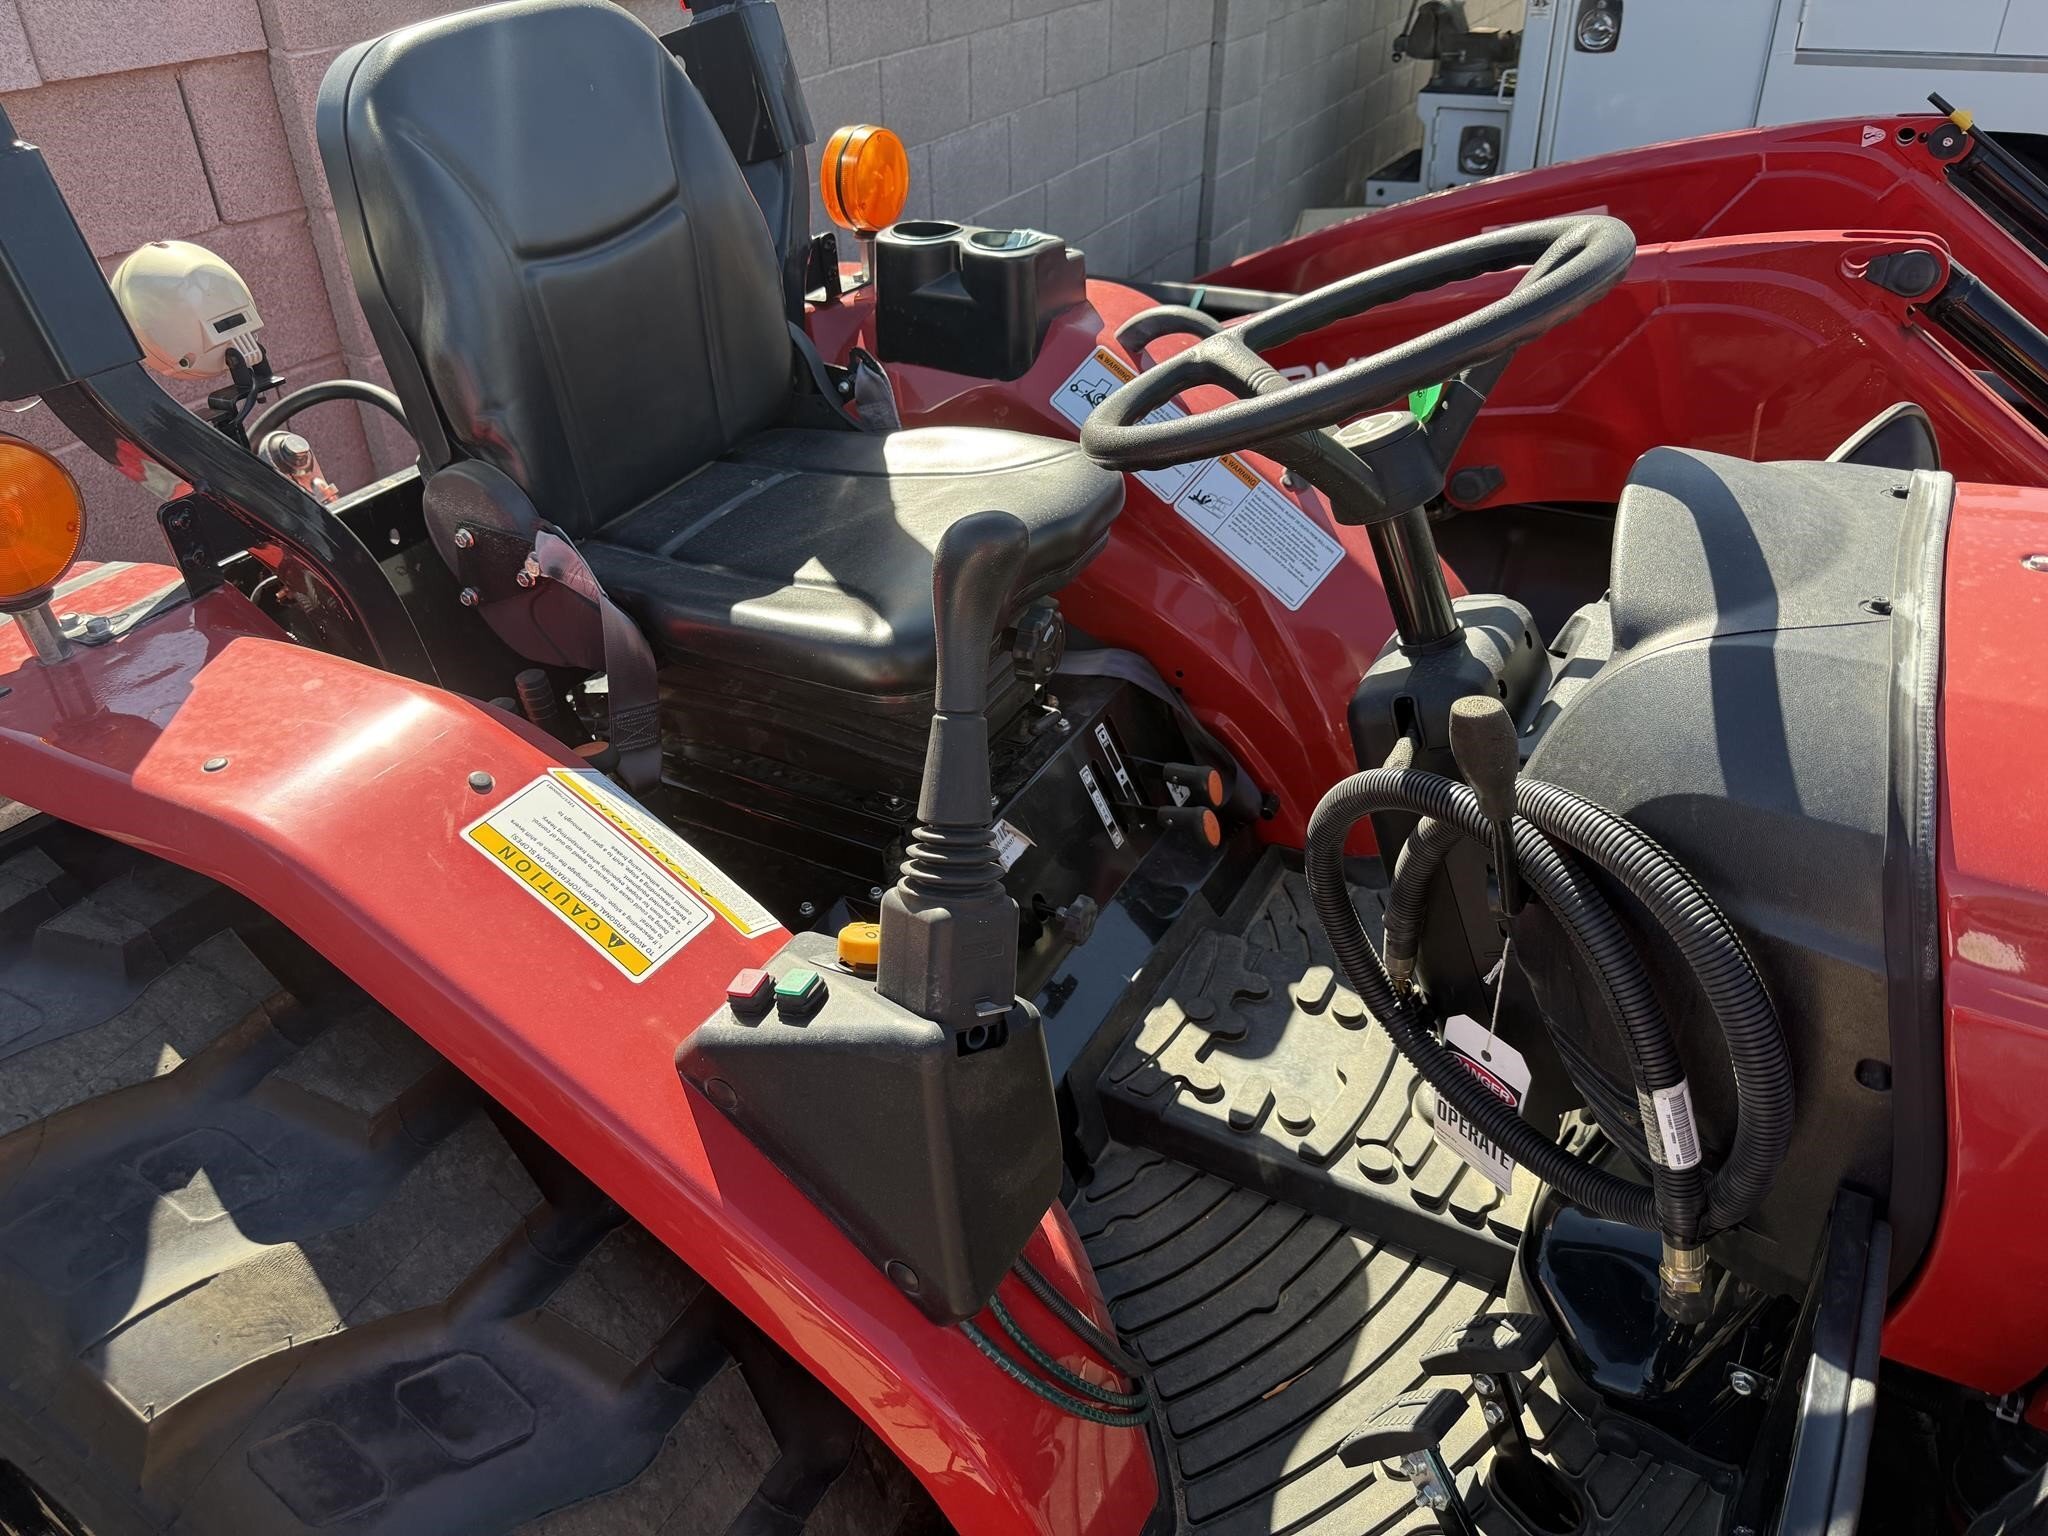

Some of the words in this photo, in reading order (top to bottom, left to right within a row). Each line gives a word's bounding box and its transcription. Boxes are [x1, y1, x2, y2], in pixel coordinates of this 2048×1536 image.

[1104, 356, 1131, 381] WARNING
[1228, 460, 1257, 487] WARNING
[510, 819, 526, 832] levers
[563, 815, 583, 831] enough
[525, 831, 537, 842] shift
[556, 837, 566, 845] out
[556, 828, 587, 854] transporting
[582, 830, 592, 839] low
[593, 801, 690, 881] CAUTION
[592, 837, 604, 848] gear
[543, 845, 559, 859] clutch
[572, 850, 588, 864] speed
[586, 852, 601, 865] when
[558, 858, 567, 867] the
[612, 855, 625, 866] shift
[627, 859, 642, 872] using
[567, 866, 594, 888] disengage
[593, 869, 610, 883] tractor
[600, 864, 626, 886] especially
[641, 872, 660, 888] without
[497, 845, 603, 932] CAUTION
[593, 887, 607, 900] never
[610, 882, 619, 891] the
[659, 886, 675, 900] speed
[619, 889, 634, 903] cause
[642, 882, 672, 906] descending
[633, 902, 648, 915] could
[649, 897, 671, 915] mounted
[649, 906, 664, 919] down
[670, 906, 687, 920] Before
[674, 901, 692, 915] control
[598, 907, 630, 933] PERSONAL
[662, 918, 675, 930] Slow
[670, 914, 681, 924] rear
[625, 915, 655, 941] descending
[653, 920, 670, 934] Doing
[628, 933, 647, 948] AVOID
[1437, 1100, 1511, 1170] OPERATE
